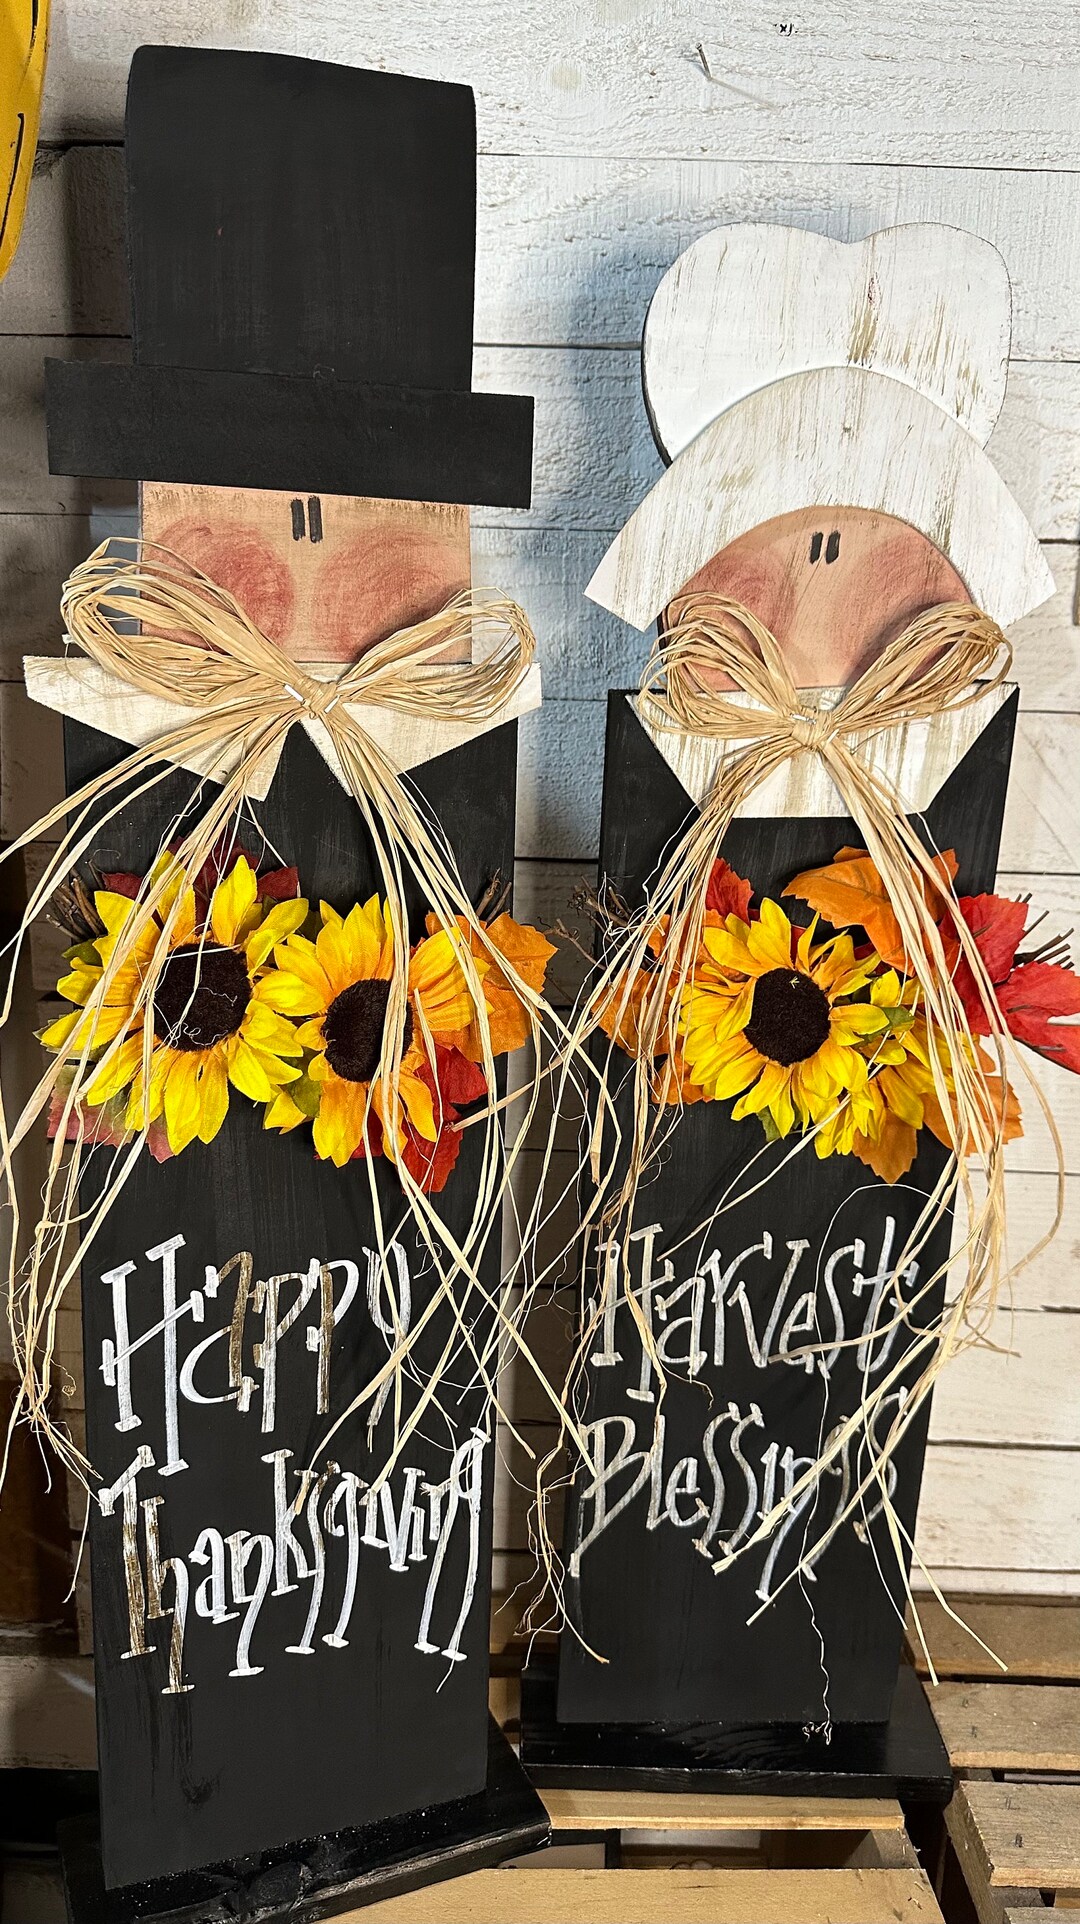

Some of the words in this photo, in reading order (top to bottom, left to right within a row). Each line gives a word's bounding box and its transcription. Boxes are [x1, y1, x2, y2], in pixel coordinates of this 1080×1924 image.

[99, 1233, 412, 1476] Happy
[587, 1215, 921, 1403] Harvest
[98, 1427, 491, 1694] Thanksgiving
[567, 1385, 911, 1602] Blessings
